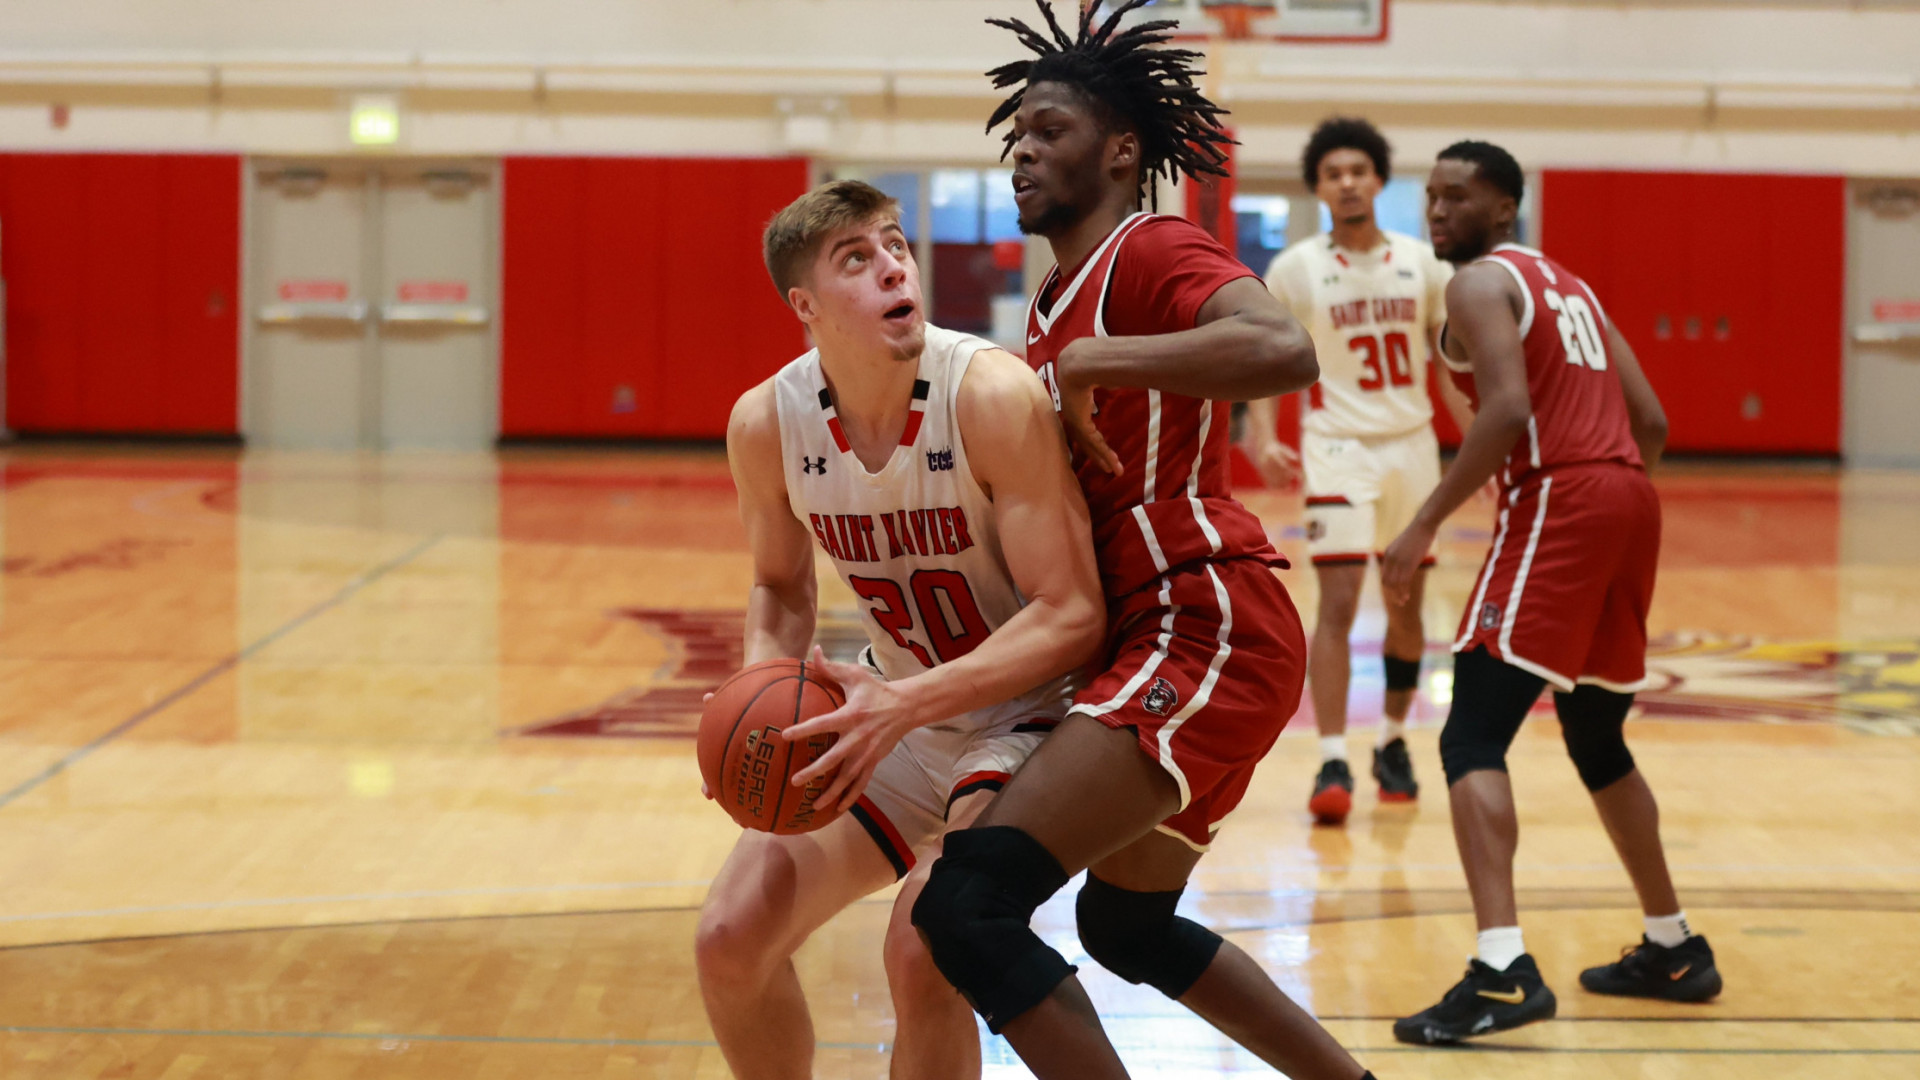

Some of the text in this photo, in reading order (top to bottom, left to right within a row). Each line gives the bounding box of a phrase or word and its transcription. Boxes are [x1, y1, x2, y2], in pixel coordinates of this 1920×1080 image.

[1348, 331, 1414, 391] 30
[1543, 288, 1607, 372] 20
[809, 506, 975, 562] SAINT XAVIER
[848, 568, 993, 669] 20
[748, 724, 781, 818] LEGACY
